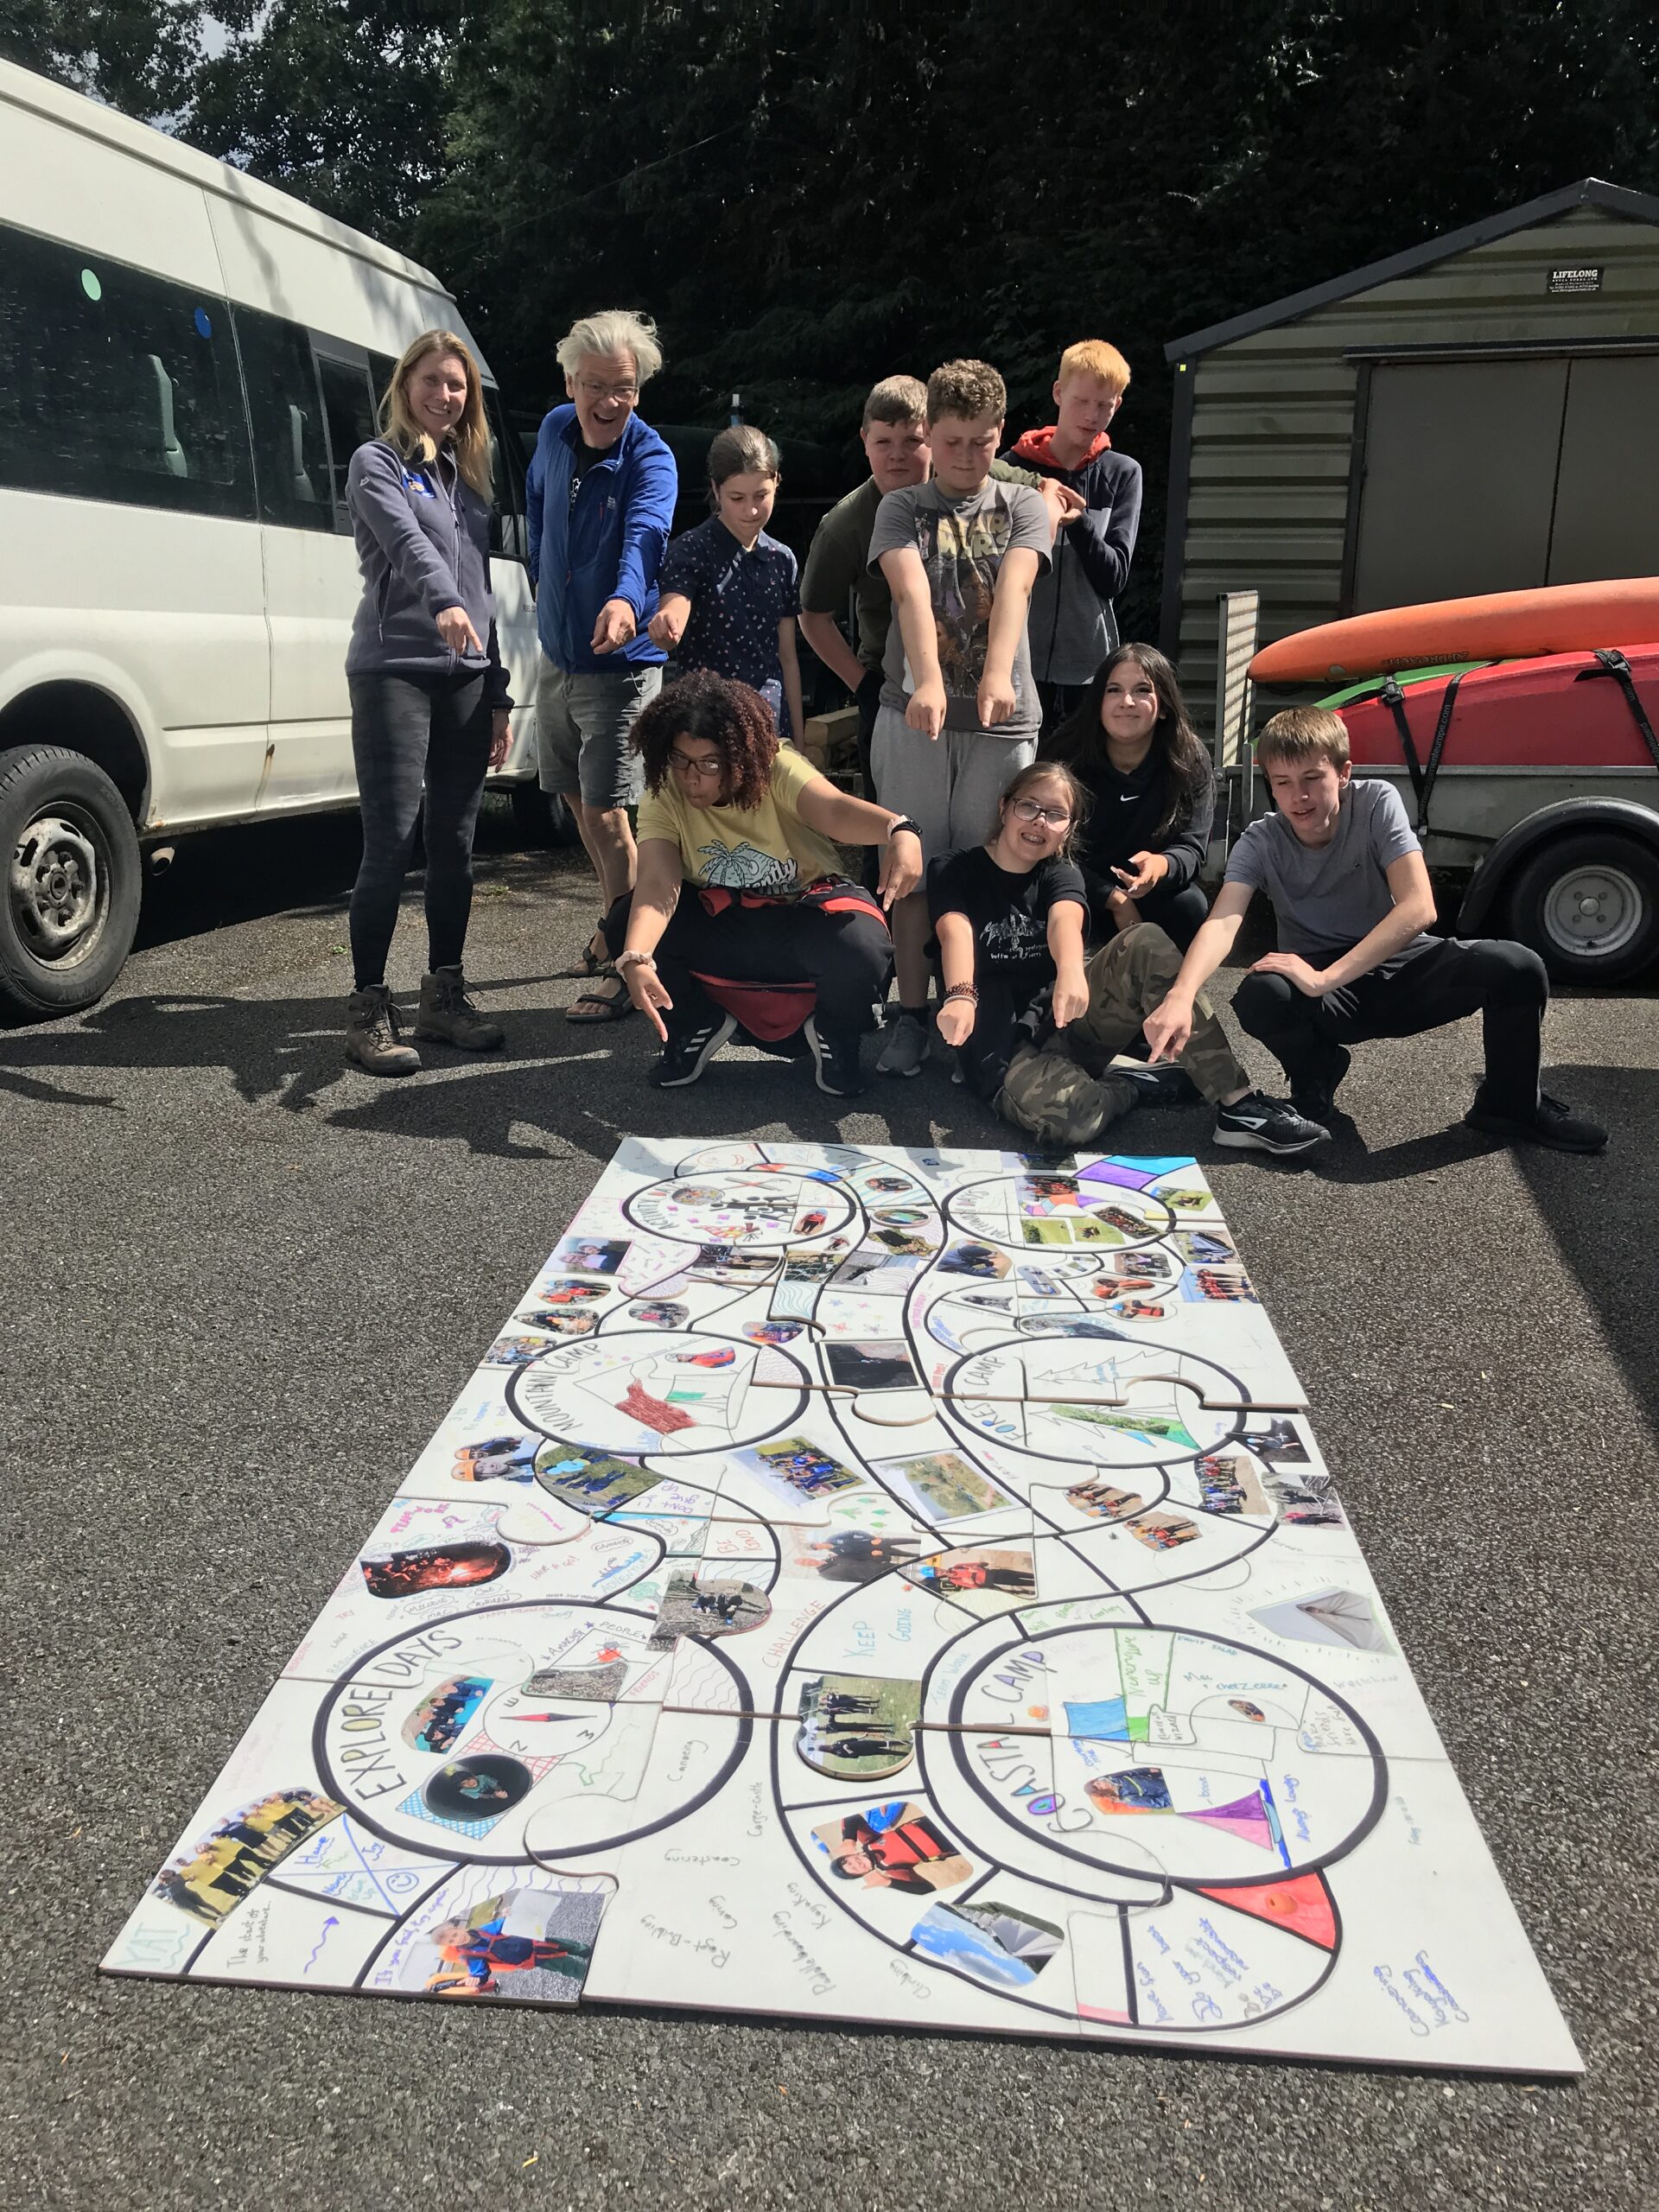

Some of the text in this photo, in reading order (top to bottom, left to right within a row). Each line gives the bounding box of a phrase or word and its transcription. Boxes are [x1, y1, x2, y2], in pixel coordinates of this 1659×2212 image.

[1553, 270, 1598, 278] LIFELONG
[544, 1343, 602, 1369] CAMP
[963, 1356, 1006, 1386] CAMP
[717, 1539, 739, 1554] BE
[762, 1600, 827, 1669] CHALLENGE
[843, 1620, 875, 1657] KEEP
[887, 1608, 912, 1643] GOING
[629, 1670, 660, 1698] FRIENDS
[340, 1630, 462, 1800] EXPLORE DAYS
[976, 1650, 1094, 1833] COASTAL CAMP
[709, 1895, 737, 1929] Caving
[786, 1882, 832, 1929] Kayaking
[115, 1923, 179, 1967] YAT
[226, 1946, 247, 1968] The
[889, 1958, 931, 1999] Climbing
[1374, 1965, 1431, 2037] Canoeing
